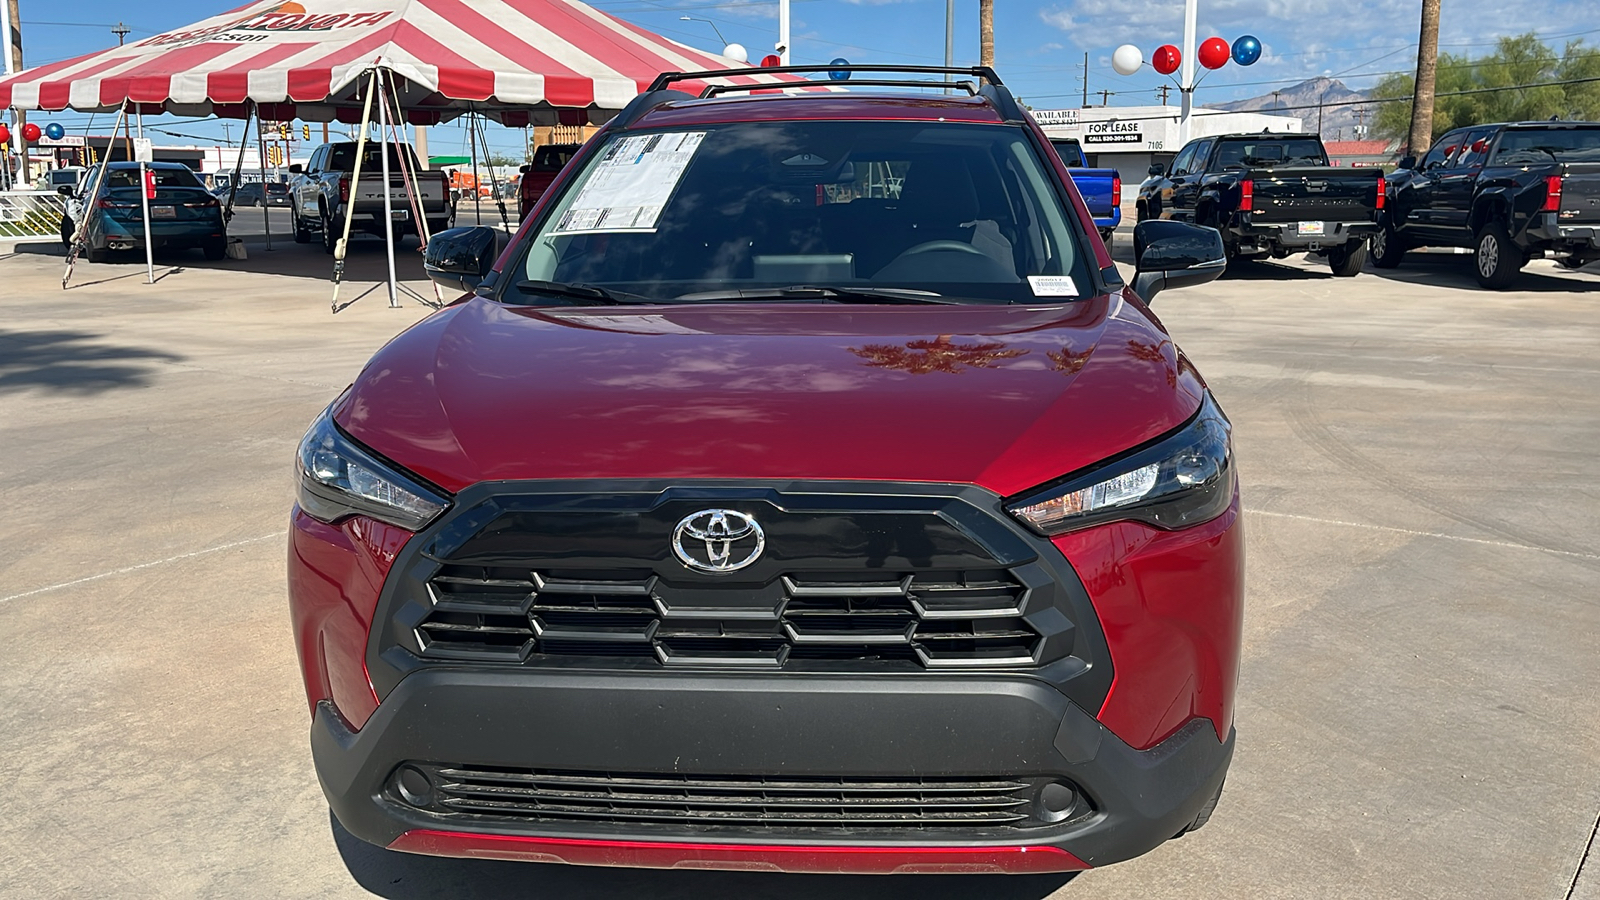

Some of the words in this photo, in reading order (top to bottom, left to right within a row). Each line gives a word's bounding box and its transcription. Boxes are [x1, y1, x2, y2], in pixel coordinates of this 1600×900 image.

[248, 11, 394, 30] TOYOTA
[1034, 111, 1079, 119] AVAILABLE
[1089, 124, 1108, 133] FOR
[1111, 123, 1138, 132] LEASE
[1148, 141, 1163, 150] 7105
